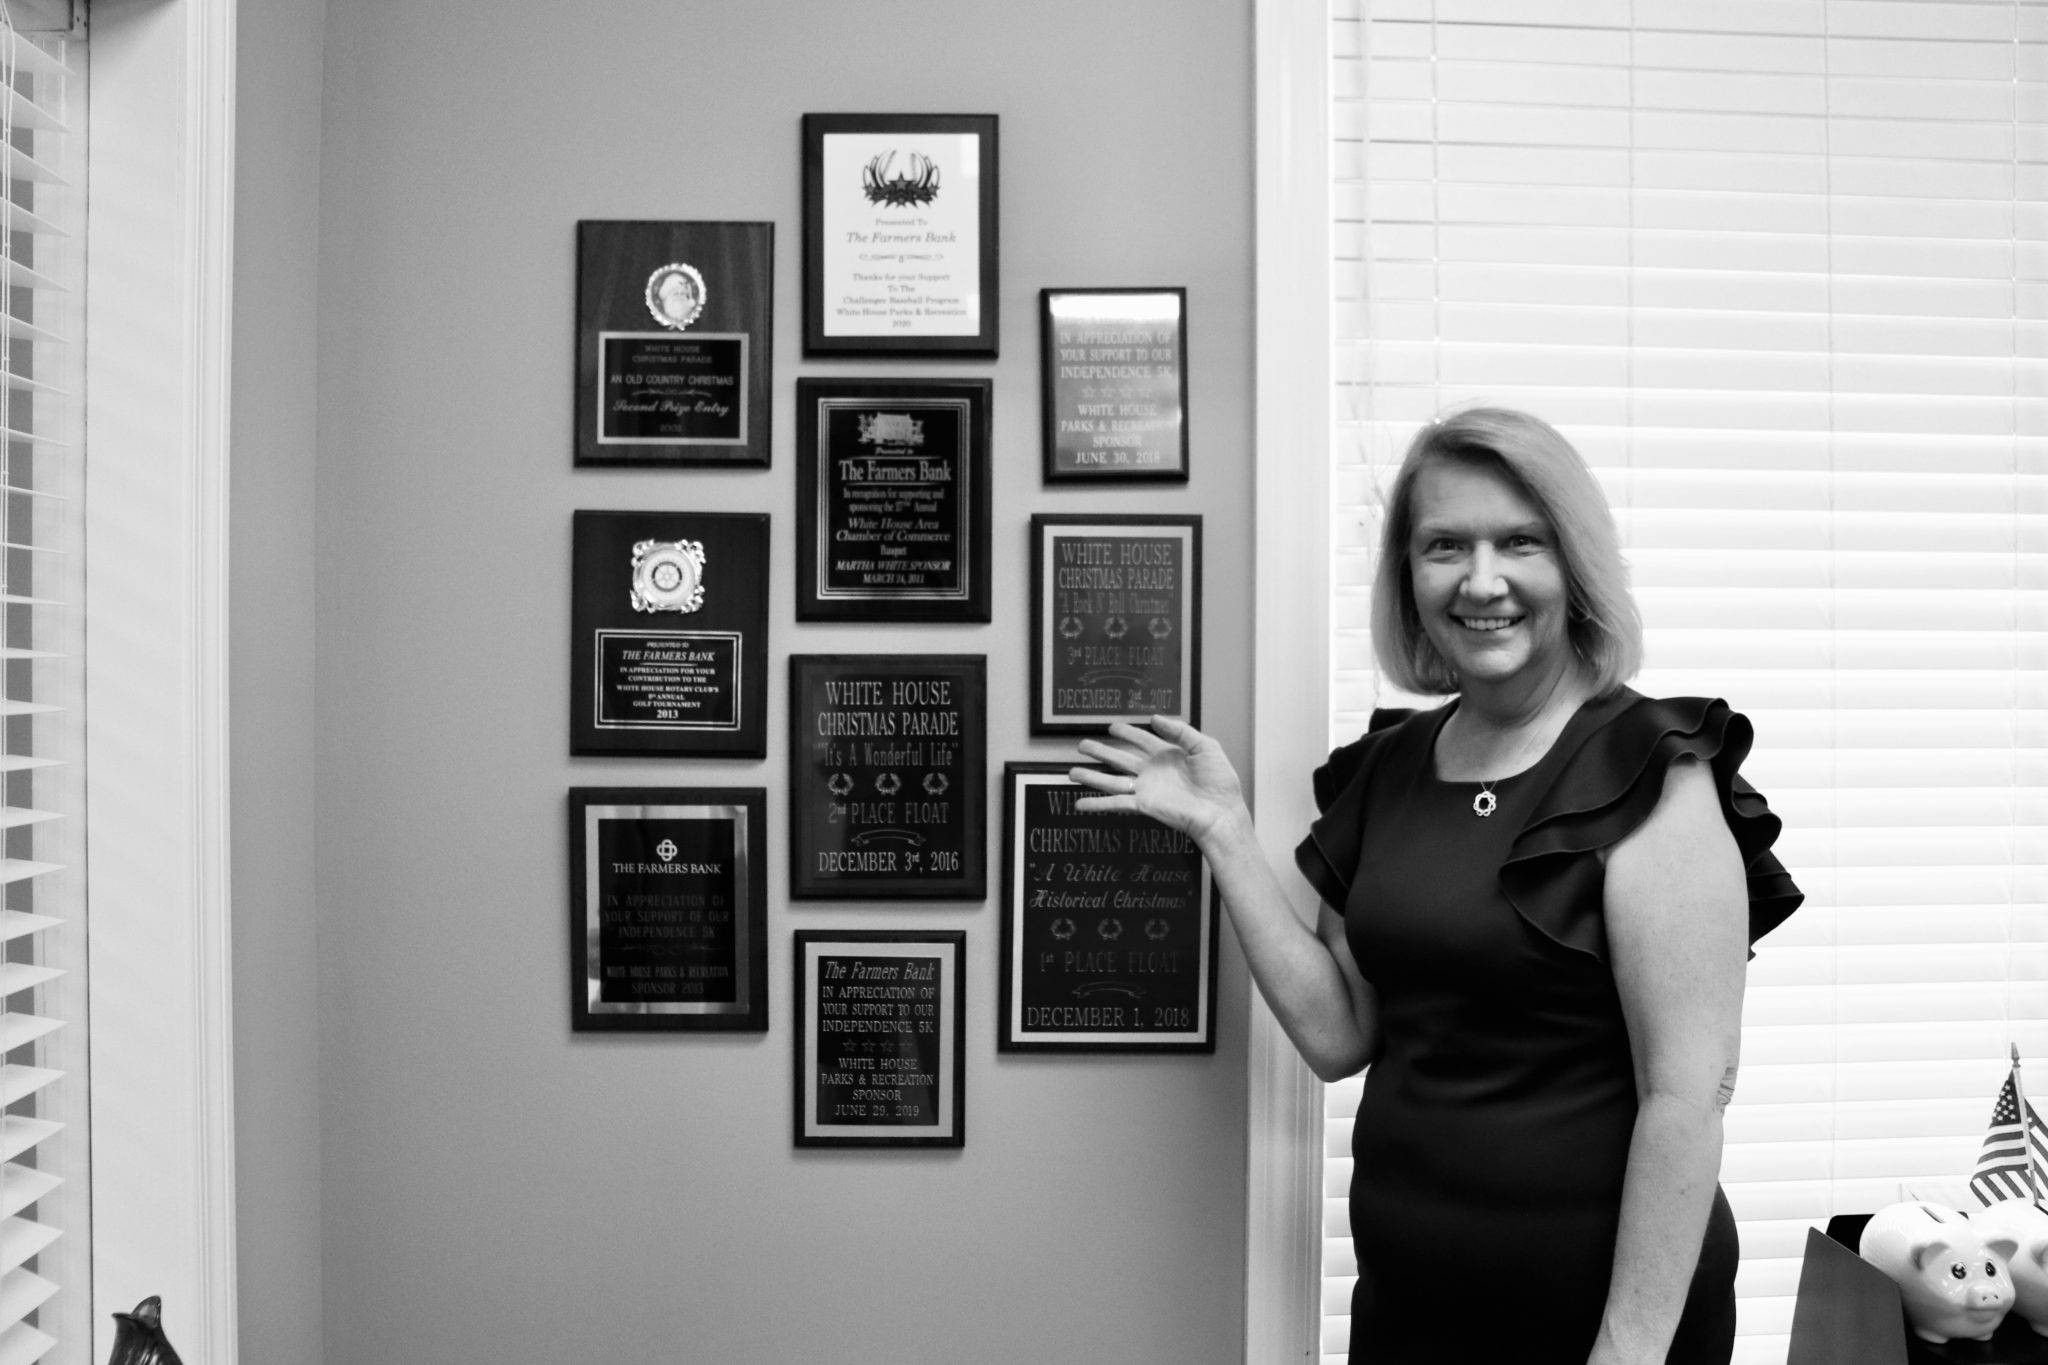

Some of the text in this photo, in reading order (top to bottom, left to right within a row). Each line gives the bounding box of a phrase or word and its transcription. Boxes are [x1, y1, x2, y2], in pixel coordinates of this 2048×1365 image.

[846, 232, 956, 243] The Farmers Bank
[1060, 331, 1171, 345] IN APPRECIATION OF
[1060, 349, 1172, 361] YOUR SUPPORT TO OUR
[1060, 366, 1151, 379] INDEPENDENCE
[610, 375, 734, 385] AN OLD COUNTRY CHRISTMAS
[612, 400, 729, 418] Second Prize Entry
[1077, 404, 1157, 416] WHITE HOUSE
[1061, 420, 1094, 432] PARKS
[1092, 436, 1142, 448] SPONSOR
[1075, 452, 1107, 464] JUNE
[838, 459, 952, 480] The Farmers Bank
[849, 517, 940, 530] White House Area
[836, 530, 951, 541] Chamber of Commerce
[1061, 543, 1173, 565] WHITE HOUSE
[836, 560, 952, 571] MARTHA WHITE SPONSOR
[1058, 568, 1174, 590] CHRISTMAS PARADE
[622, 650, 716, 662] THE FARMERS BANK
[1084, 646, 1121, 666] PLACE
[1128, 646, 1166, 666] FLOAT
[628, 675, 681, 683] CONTRIBUTION
[693, 676, 707, 684] THE
[616, 684, 640, 692] WHITE
[641, 684, 665, 692] HOUSE
[665, 685, 693, 693] ROTARY
[825, 681, 951, 705] WHITE HOUSE
[656, 693, 686, 701] ANNUAL
[1057, 688, 1122, 709] DECEMBER
[1150, 688, 1174, 709] 2017
[632, 701, 701, 709] GOLF TOURNAMENT
[656, 709, 680, 720] 2013
[817, 712, 959, 736] CHRISTMAS PARADE
[849, 742, 858, 766] A
[864, 742, 923, 766] Wonderful
[851, 802, 896, 824] PLACE
[905, 802, 950, 824] FLOAT
[1030, 828, 1195, 854] CHRISTMAS PARADE
[818, 851, 898, 872] DECEMBER
[930, 851, 960, 872] 2016
[612, 863, 723, 874] THE FARMERS BANK
[1063, 863, 1122, 882] White
[1130, 863, 1194, 882] House
[607, 895, 726, 907] IN APPRECIATION OF
[1028, 889, 1109, 909] Historical
[604, 911, 729, 923] YOUR SUPPORT OF OUR
[618, 926, 716, 938] INDEPENDENCE 5K
[1064, 952, 1118, 973] PLACE
[1128, 952, 1178, 973] FLOAT
[825, 961, 935, 980] The Farmers Bank
[631, 982, 676, 994] SPONSOR
[822, 986, 935, 999] IN APPRECIATION OF
[822, 1003, 935, 1016] YOUR SUPPORT TO OUR
[1027, 1007, 1125, 1027] DECEMBER
[1153, 1007, 1190, 1027] 2018
[822, 1020, 934, 1033] INDEPENDENCE 5K
[838, 1057, 918, 1070] WHITE HOUSE
[821, 1074, 934, 1086] PARKS & RECREATION
[852, 1089, 902, 1101] SPONSOR
[834, 1104, 867, 1116] JUNE
[895, 1104, 921, 1116] 2019
